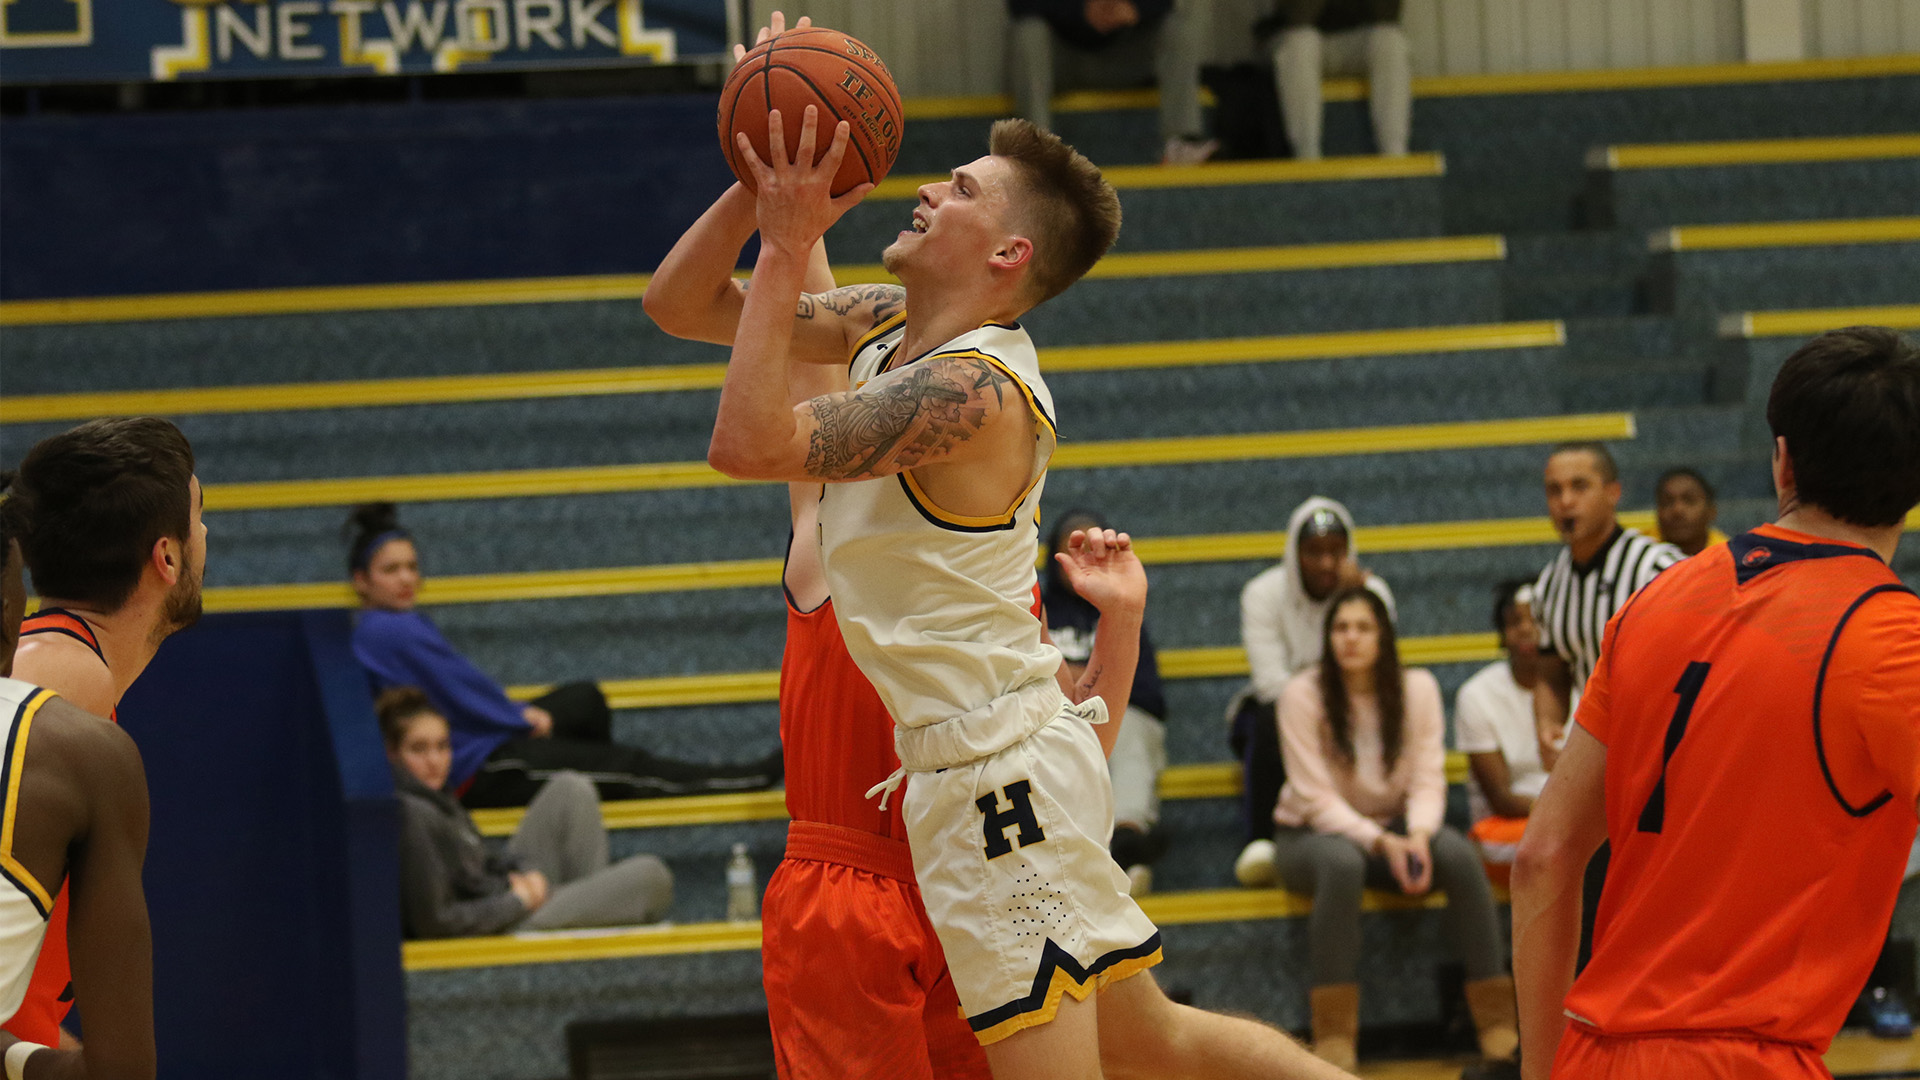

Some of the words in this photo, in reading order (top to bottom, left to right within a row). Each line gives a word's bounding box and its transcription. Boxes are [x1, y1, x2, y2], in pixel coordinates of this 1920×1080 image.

[215, 0, 619, 60] NETWORK
[860, 111, 885, 147] LEGACY
[1637, 661, 1712, 834] 1
[975, 779, 1046, 861] H
